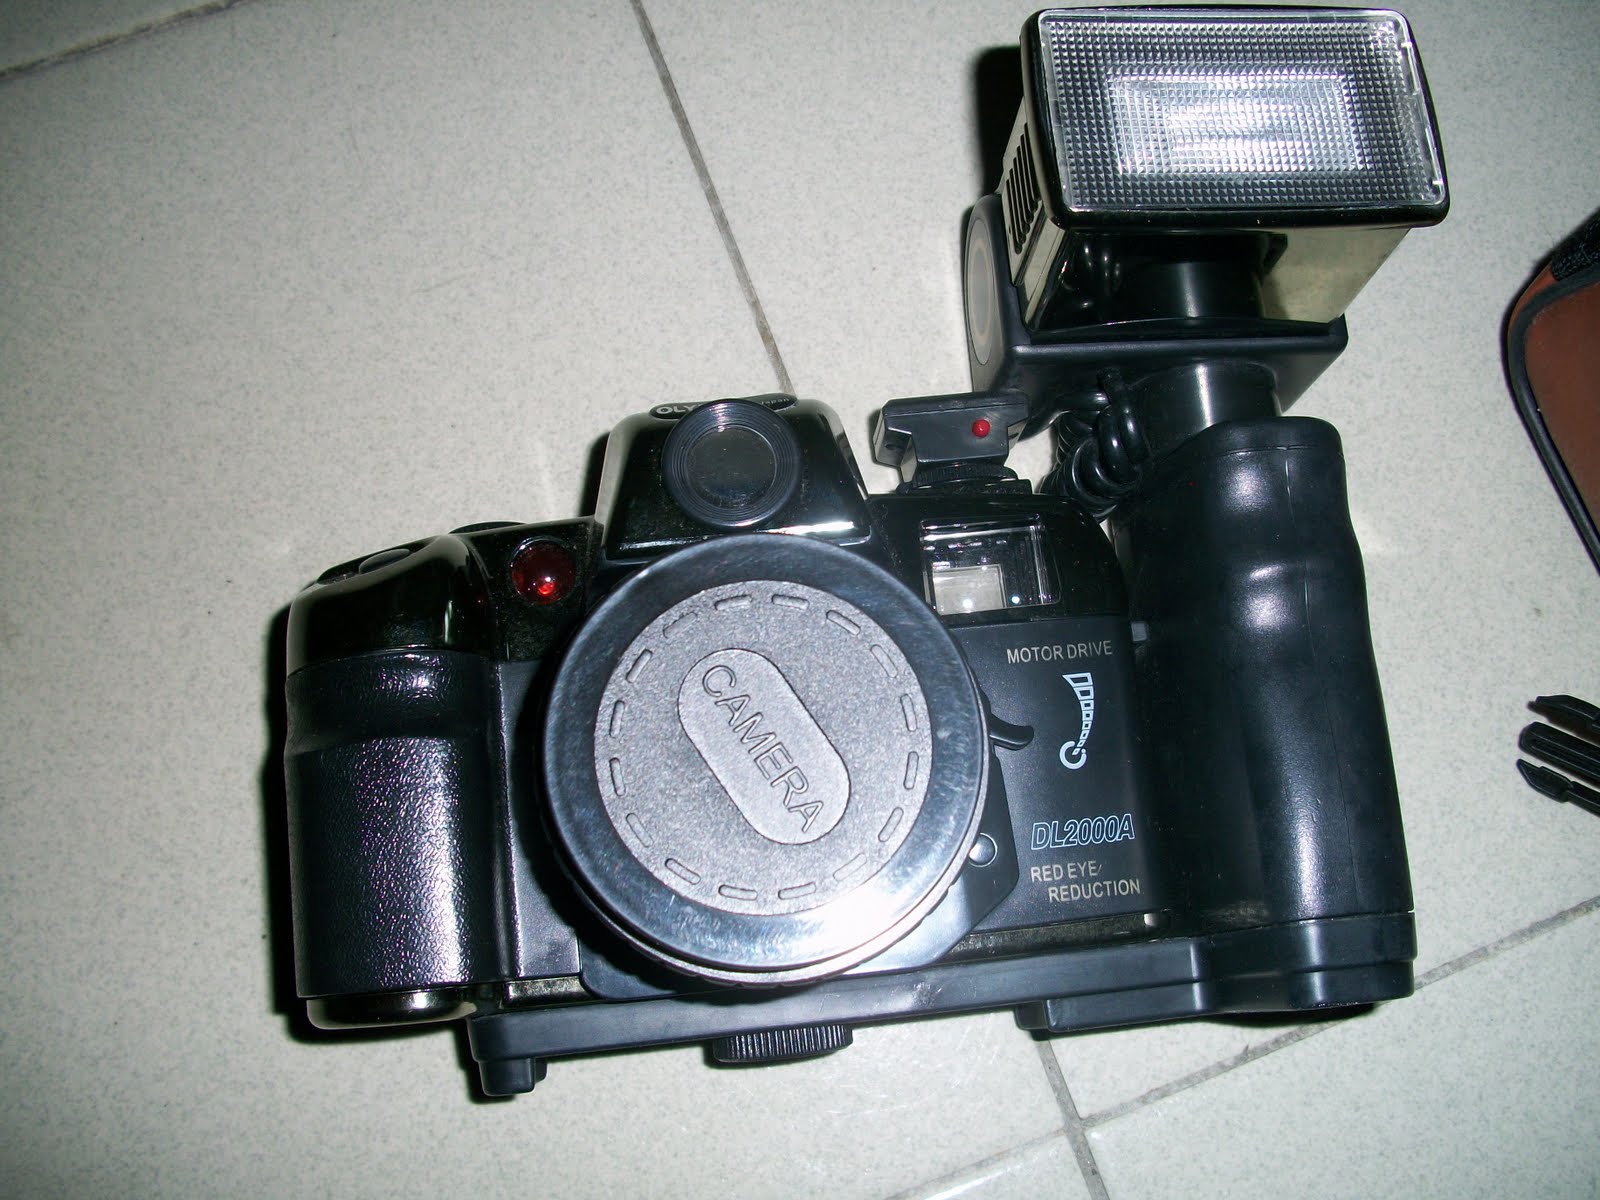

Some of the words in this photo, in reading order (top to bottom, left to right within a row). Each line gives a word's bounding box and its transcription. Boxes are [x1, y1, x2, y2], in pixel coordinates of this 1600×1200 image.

[1006, 644, 1064, 664] MOTOR
[1067, 640, 1114, 660] DRIVE
[702, 665, 824, 833] CAMERA
[1031, 813, 1136, 850] DL2000A
[1030, 864, 1064, 883] RED
[1047, 878, 1141, 903] REDUCTION
